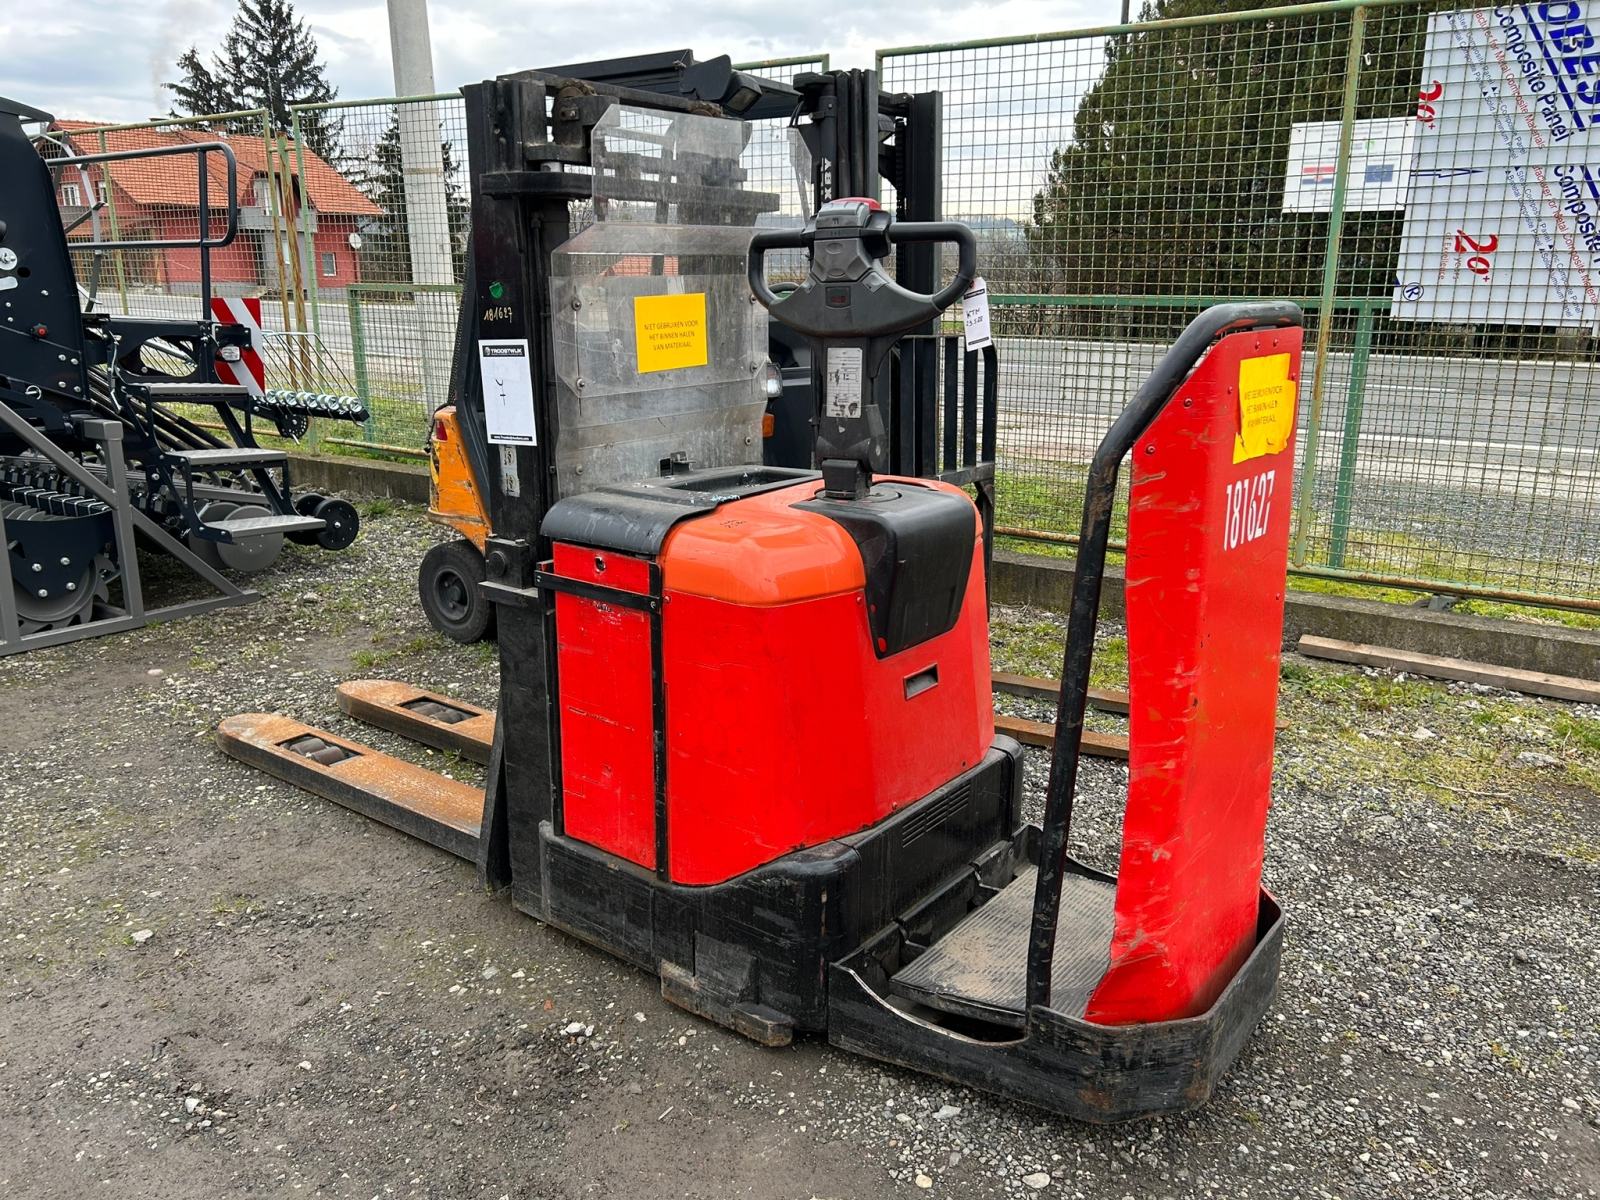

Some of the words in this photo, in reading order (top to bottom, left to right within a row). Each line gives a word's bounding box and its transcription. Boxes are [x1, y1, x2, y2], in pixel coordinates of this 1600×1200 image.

[1494, 6, 1546, 93] Composite
[1536, 91, 1575, 142] Panel
[1495, 50, 1512, 75] Metal
[1505, 73, 1529, 114] Composite
[1524, 113, 1546, 150] Materials
[1440, 242, 1452, 280] Excellence
[1562, 232, 1586, 274] Composite
[483, 306, 512, 323] 181627
[644, 323, 656, 331] NIET
[684, 319, 698, 327] VOOR
[653, 343, 664, 351] VAN
[664, 340, 692, 350] MATERIAAL
[1223, 470, 1275, 552] 181627
